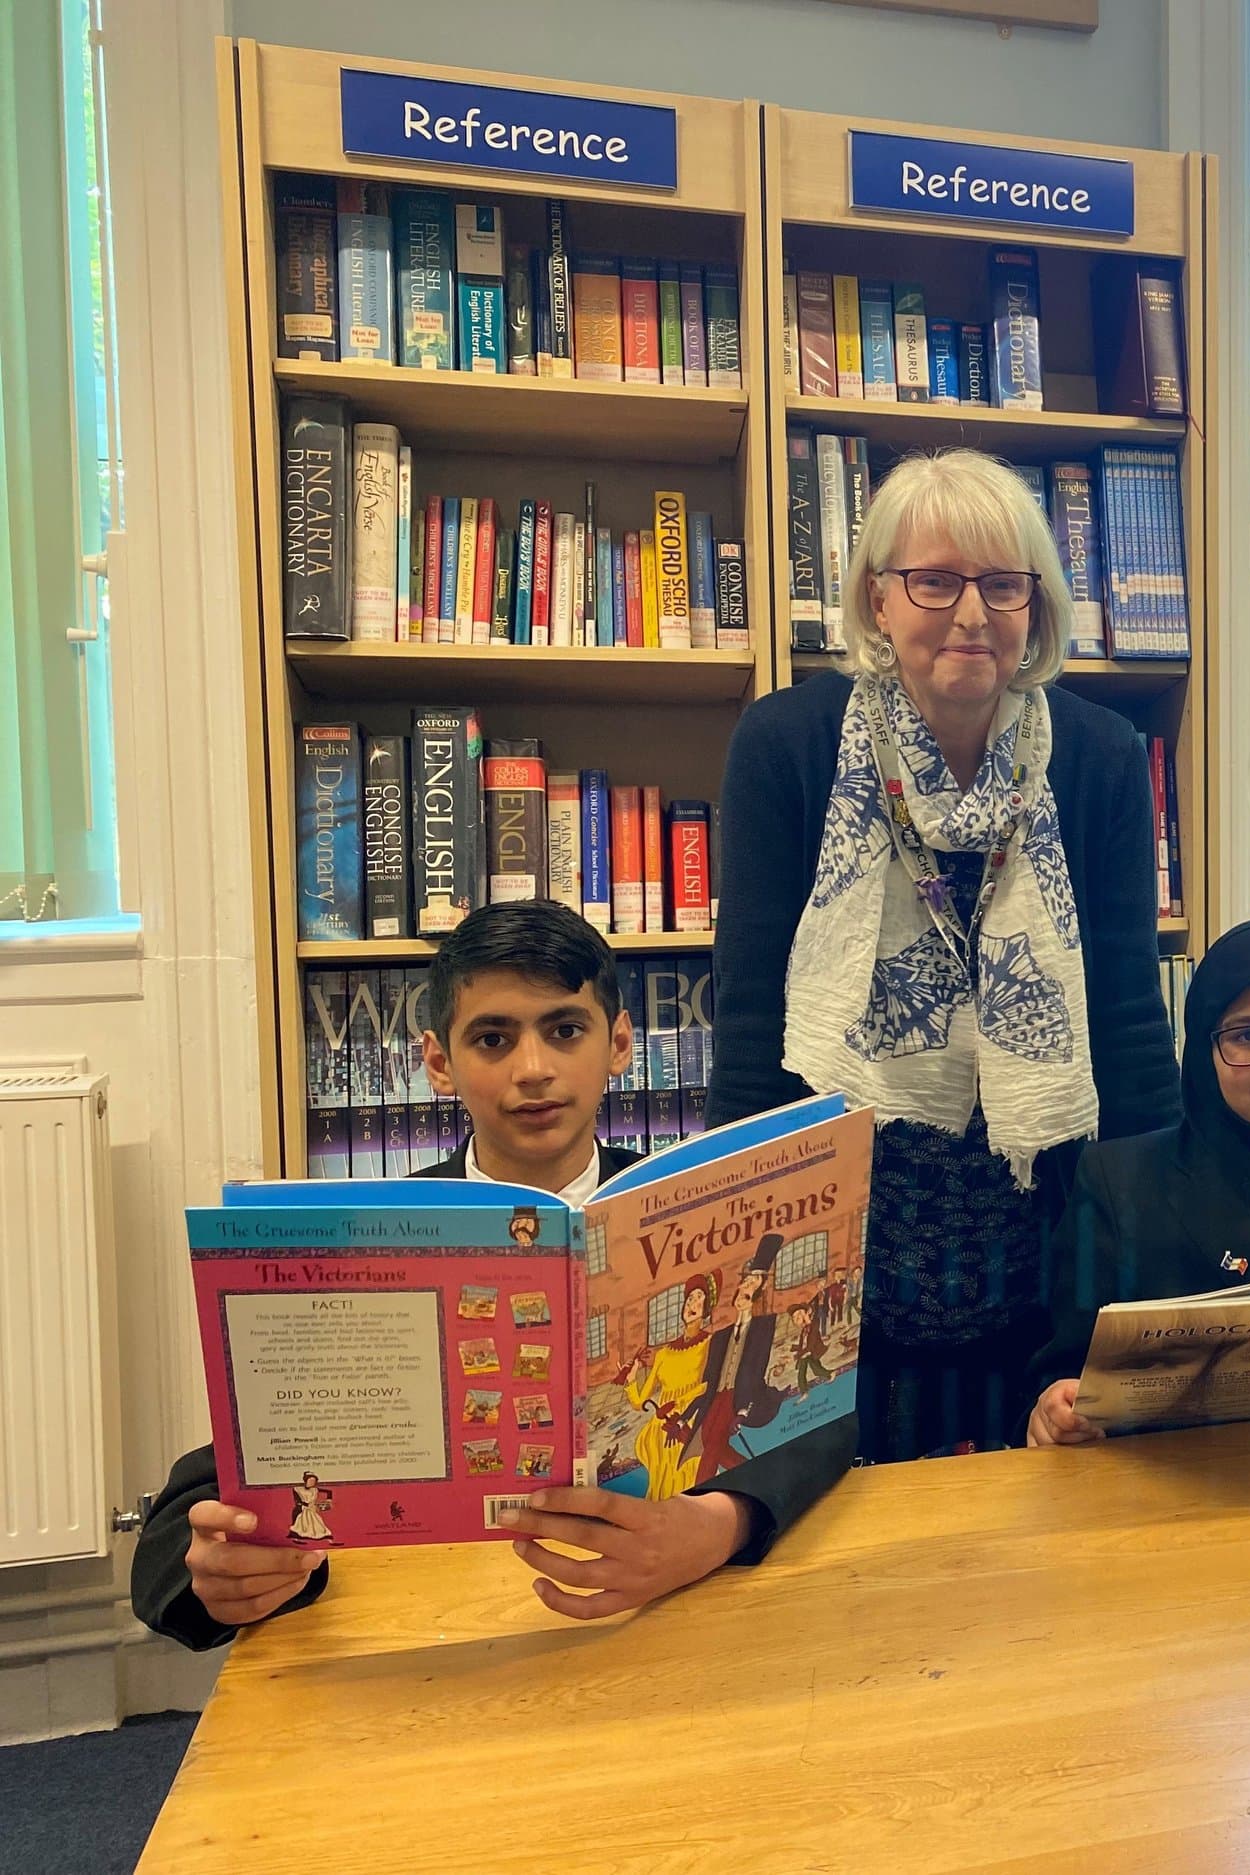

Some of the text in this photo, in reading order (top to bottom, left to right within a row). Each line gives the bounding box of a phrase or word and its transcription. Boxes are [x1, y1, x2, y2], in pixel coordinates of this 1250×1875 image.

[402, 99, 630, 164] Reference
[901, 160, 1092, 214] Reference
[351, 219, 365, 279] ENGLISH
[409, 221, 425, 313] LITERATURE
[425, 223, 441, 290] ENGLISH
[551, 219, 566, 333] DICTIONARY OF BELIEFS
[468, 289, 481, 323] English
[483, 290, 496, 352] Dictionary of
[687, 299, 700, 352] BOOK OF
[1002, 281, 1030, 400] Dictionary
[725, 319, 738, 372] FAMILY
[905, 319, 918, 382] THESAURUS
[355, 448, 385, 500] English
[795, 473, 809, 494] The
[1058, 481, 1091, 496] English
[286, 448, 306, 577] DICTIONARY
[306, 448, 333, 577] ENCARTA
[792, 495, 812, 535] A-Z
[853, 473, 864, 522] The Book of
[362, 499, 381, 536] Verse
[521, 515, 533, 535] THE
[537, 517, 548, 536] THE
[461, 542, 472, 559] Cry
[659, 497, 682, 576] OXFORD
[721, 544, 738, 556] DK
[1066, 498, 1092, 602] Thesaur
[518, 565, 531, 594] BOOK
[535, 566, 547, 594] BOOK
[794, 550, 815, 597] ART
[661, 578, 673, 616] THESAU
[671, 578, 687, 617] SCHO
[719, 562, 730, 625] ENCYCLOPEDIA
[728, 562, 744, 624] CONCISE
[315, 729, 349, 740] Collins
[416, 718, 460, 729] OXFORD
[869, 710, 890, 746] STAFF
[305, 743, 349, 760] English
[494, 766, 529, 775] COLLINS
[305, 765, 344, 905] Dictionary
[365, 786, 385, 874] ENGLISH
[382, 784, 402, 874] CONCISE
[423, 738, 455, 896] ENGLISH
[550, 820, 562, 885] DICTIONARY
[560, 810, 573, 894] PLAIN ENGLISH
[589, 777, 599, 900] OXFORD Concise School Dictionary
[367, 874, 402, 882] DICTIONARY
[682, 826, 703, 904] ENGLISH
[318, 1110, 337, 1118] 2008
[358, 1108, 377, 1116] 2008
[364, 1118, 371, 1128] 2
[393, 1116, 400, 1126] 3
[413, 1105, 432, 1113] 2008
[419, 1114, 426, 1124] 4
[443, 1113, 449, 1123] 5
[622, 1102, 633, 1112] 13
[623, 1116, 634, 1125] M
[659, 1101, 669, 1110] 14
[323, 1134, 333, 1143] A
[325, 1120, 331, 1130] 1
[364, 1131, 371, 1141] B
[442, 1127, 451, 1136] D
[641, 1135, 836, 1214] The Gruesome Truth About
[726, 1197, 757, 1220] The
[215, 1219, 442, 1239] The Gruesome Truth About
[637, 1182, 838, 1281] Victorians
[255, 1262, 407, 1284] The Victorians
[311, 1299, 354, 1311] FACT!
[276, 1387, 402, 1400] DID YOU KNOW?
[278, 1454, 325, 1462] Buckingham
